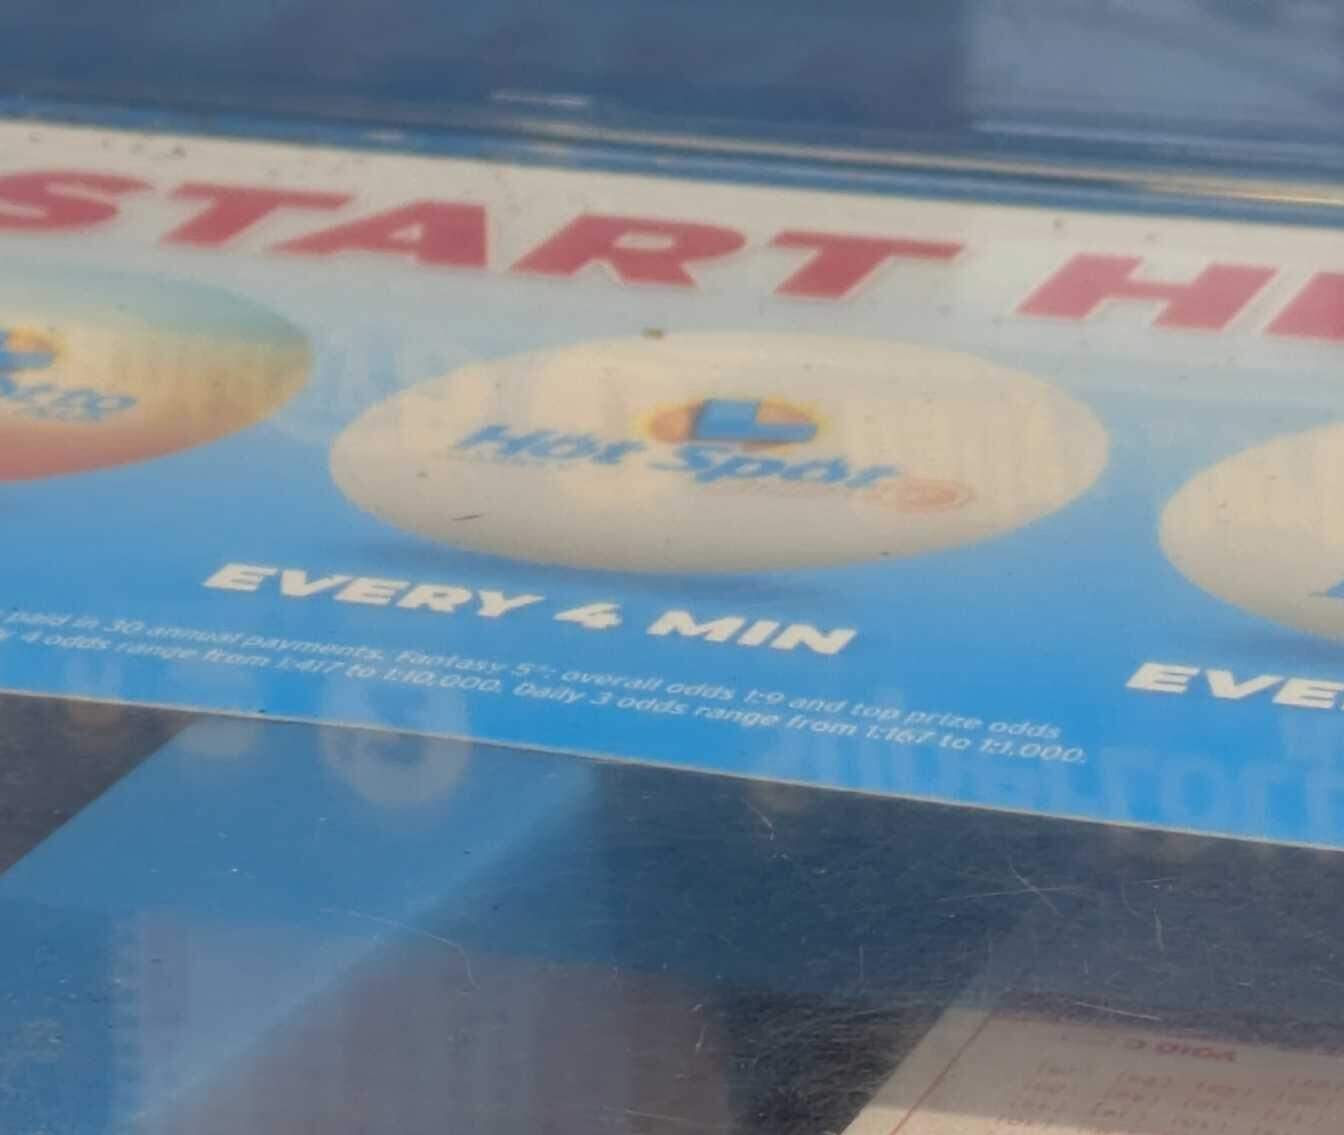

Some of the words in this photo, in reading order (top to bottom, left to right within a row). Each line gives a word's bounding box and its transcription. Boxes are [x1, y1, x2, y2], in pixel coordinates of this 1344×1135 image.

[202, 563, 545, 619] EVERY
[553, 602, 623, 630] 4
[647, 609, 856, 655] MIN
[104, 618, 145, 635] 30
[146, 626, 243, 645] annual
[395, 650, 511, 676] Fantasy
[561, 670, 662, 693] overall
[665, 683, 735, 702] odds
[789, 697, 848, 715] and
[851, 703, 904, 723] top
[903, 709, 984, 731] prize
[988, 720, 1061, 740] odds
[345, 663, 379, 680] to
[511, 681, 584, 706] Daily
[588, 691, 612, 705] 3
[616, 697, 689, 717] odds
[694, 705, 780, 728] range
[784, 714, 858, 736] from
[866, 723, 937, 746] 1:167
[938, 732, 973, 751] to
